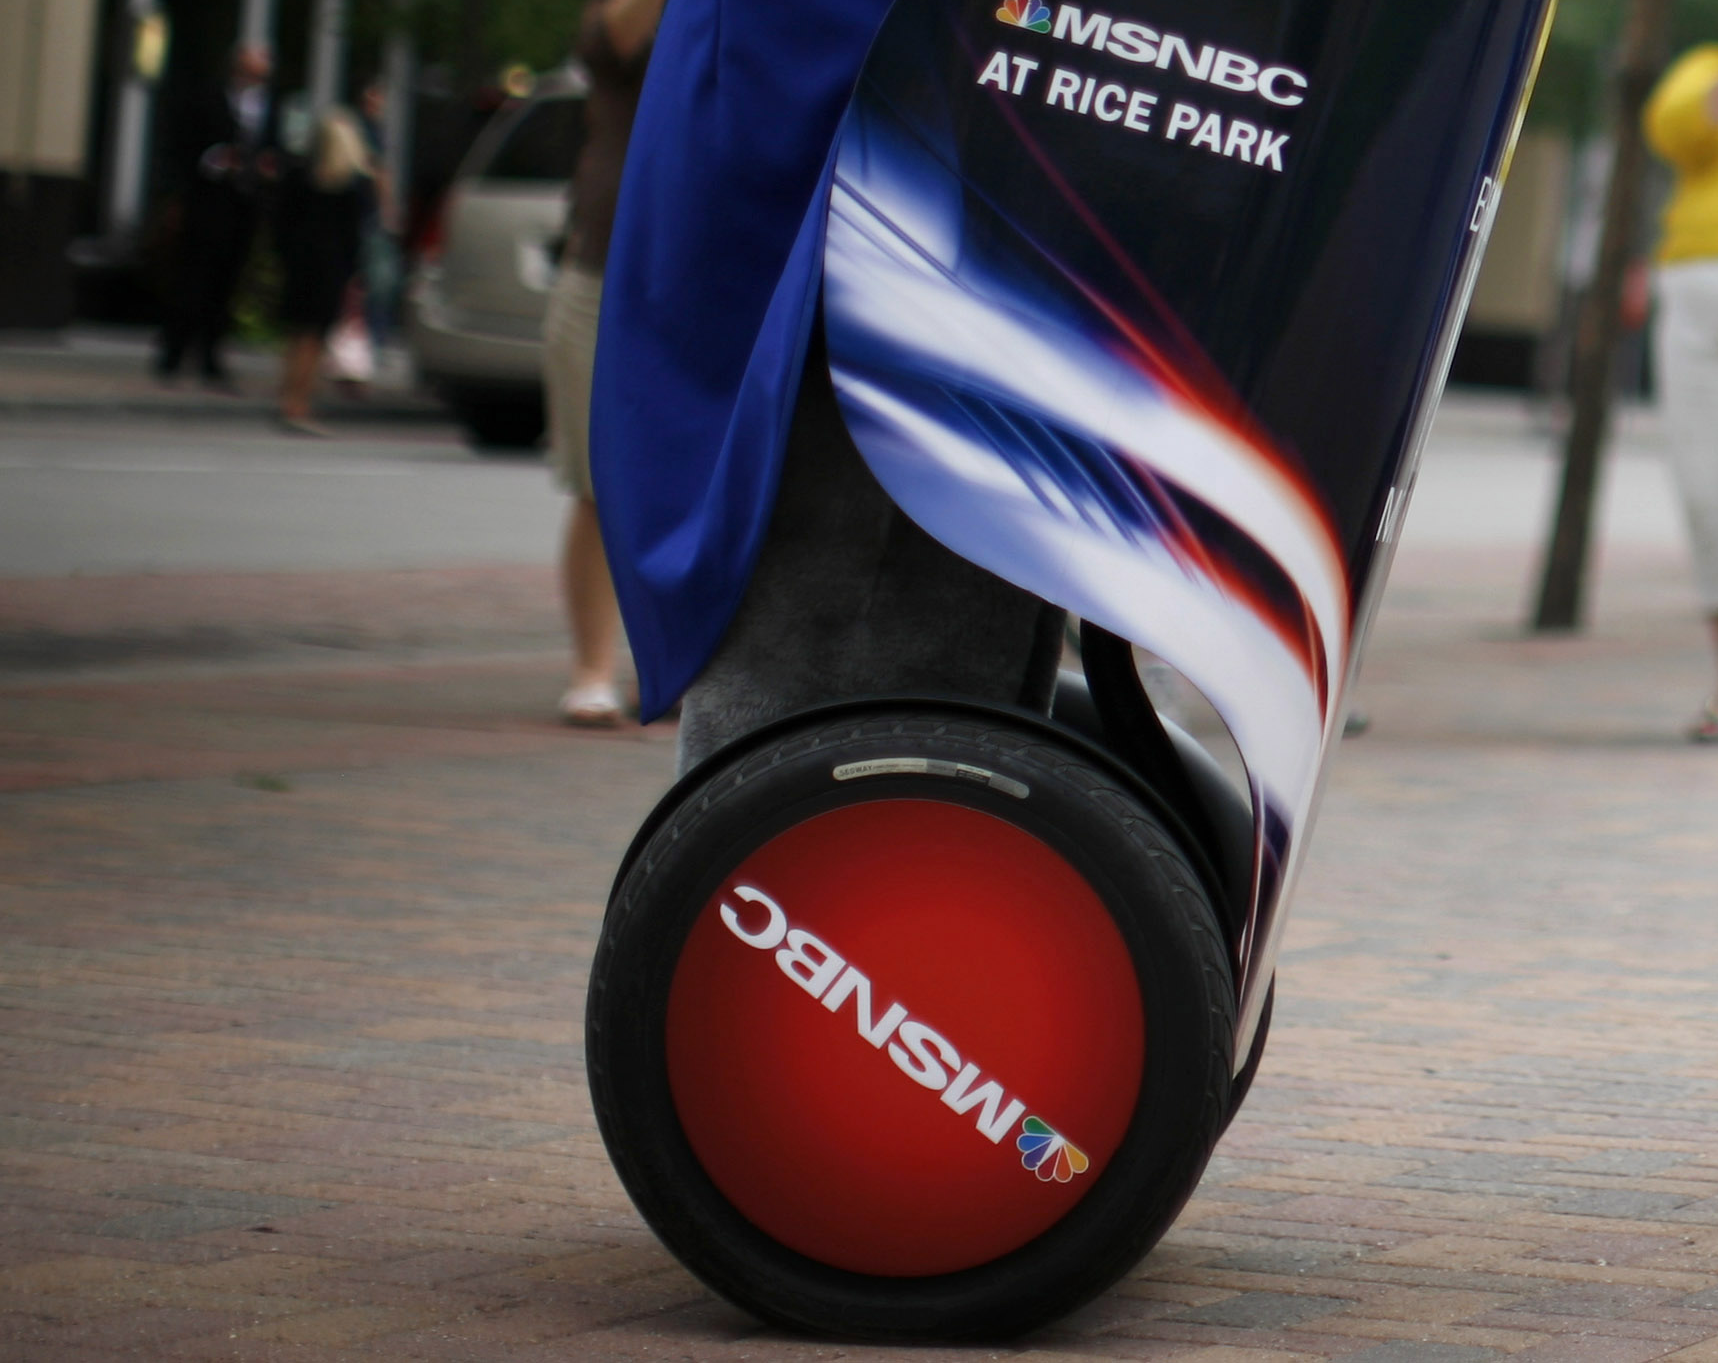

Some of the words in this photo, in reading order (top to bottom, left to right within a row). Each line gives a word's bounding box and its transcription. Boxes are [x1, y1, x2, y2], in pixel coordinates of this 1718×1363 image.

[977, 51, 1039, 96] AT
[1046, 68, 1158, 133] RICE
[1165, 102, 1290, 172] PARK
[1052, 4, 1308, 106] MSNBC
[719, 885, 1027, 1146] MSNBC
